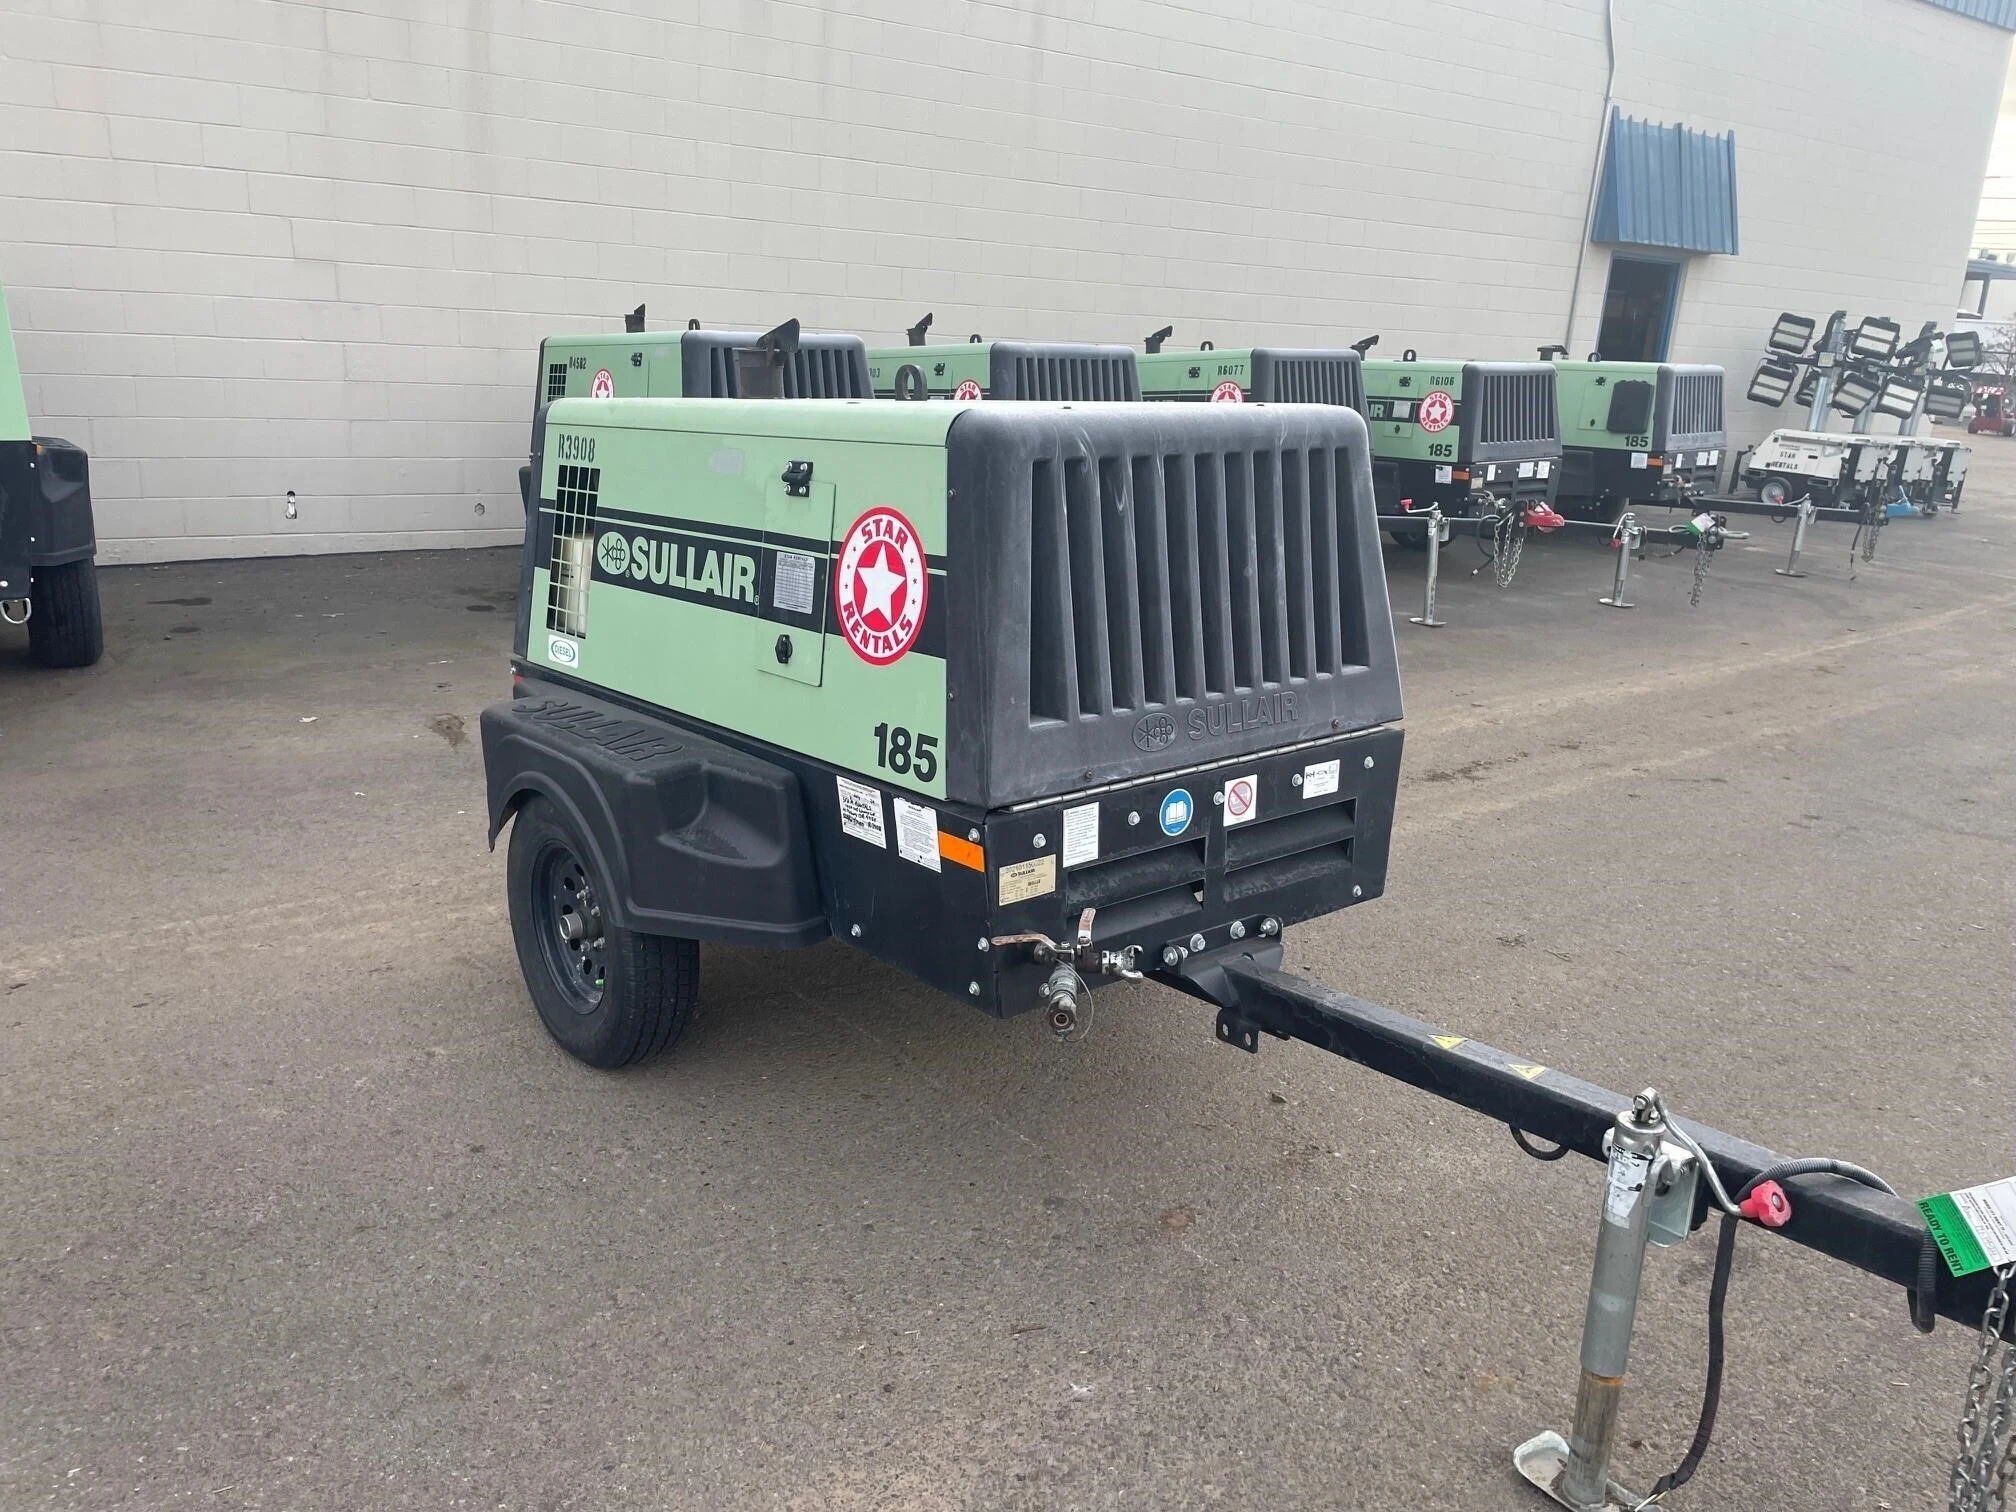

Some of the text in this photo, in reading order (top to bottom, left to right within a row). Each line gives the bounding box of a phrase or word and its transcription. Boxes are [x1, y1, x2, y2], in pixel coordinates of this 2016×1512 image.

[1217, 364, 1245, 376] R6077
[960, 381, 977, 392] STAR
[1219, 384, 1237, 393] STAR
[1429, 393, 1448, 402] STAR
[1421, 417, 1448, 430] RENTALS
[558, 433, 596, 463] R3908
[1624, 435, 1649, 448] 185
[1428, 443, 1453, 457] 185
[1780, 451, 1796, 459] STAR
[861, 518, 909, 552] STAR
[630, 535, 756, 603] SULLAIR
[843, 600, 913, 654] RENTALS
[554, 644, 572, 658] DIESEL
[1187, 690, 1299, 741] SULLAIR
[874, 722, 939, 783] 185
[1918, 1201, 1964, 1272] READY TO RENT
